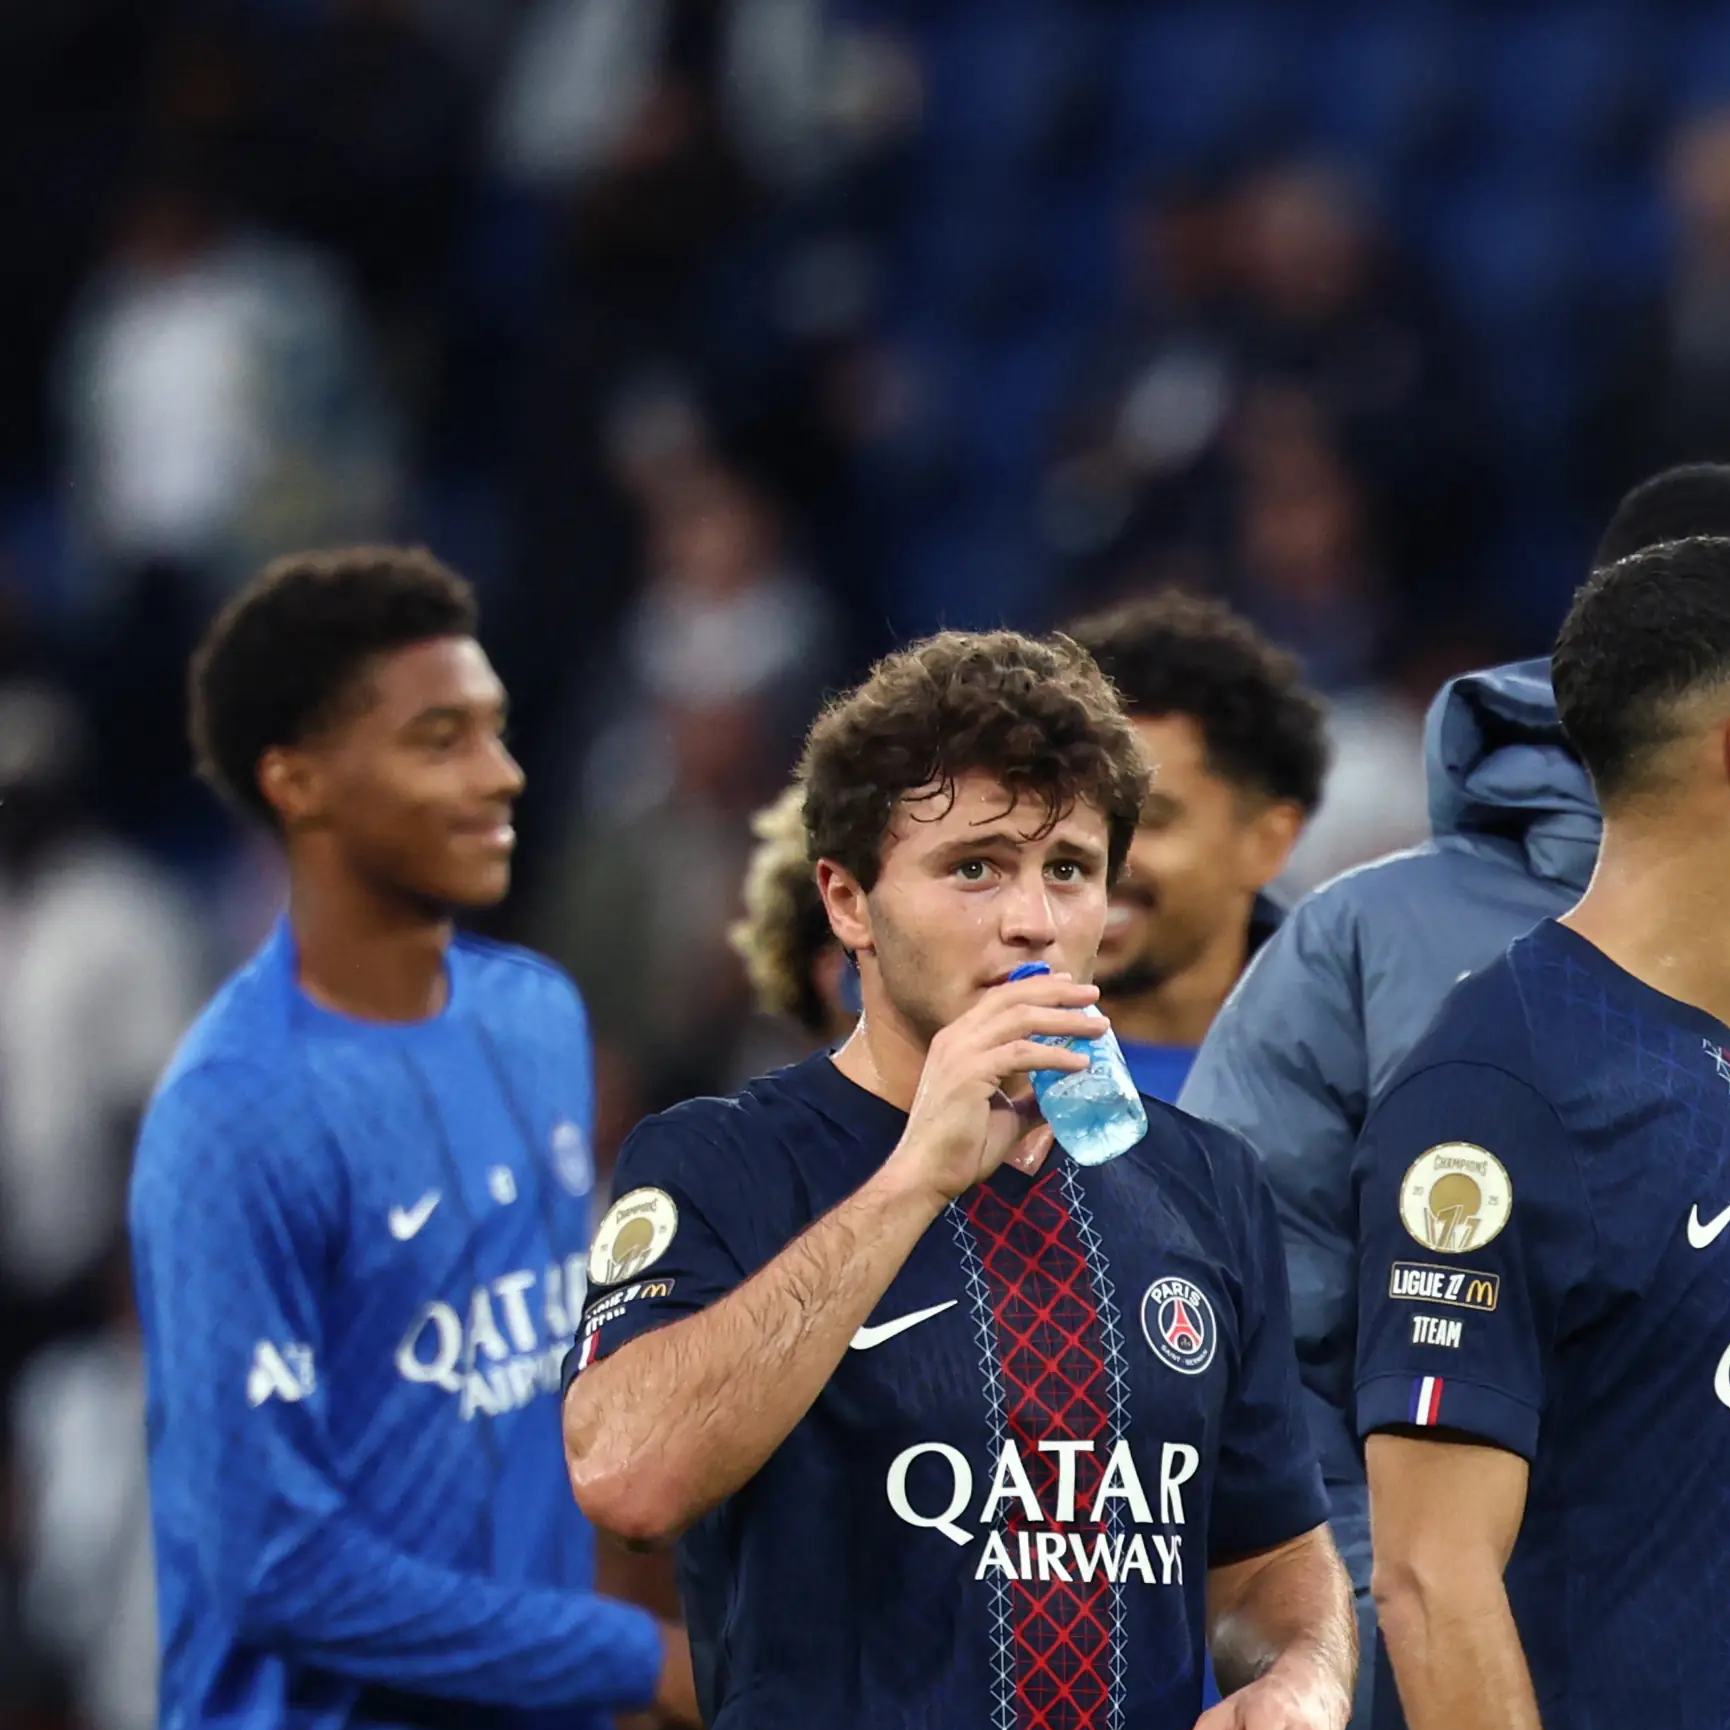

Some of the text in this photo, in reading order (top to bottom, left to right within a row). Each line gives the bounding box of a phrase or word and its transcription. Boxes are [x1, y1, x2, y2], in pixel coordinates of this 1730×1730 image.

[1151, 1282, 1201, 1307] PARIS
[1392, 1268, 1446, 1299] LIGUE
[886, 1438, 1199, 1546] QATAR
